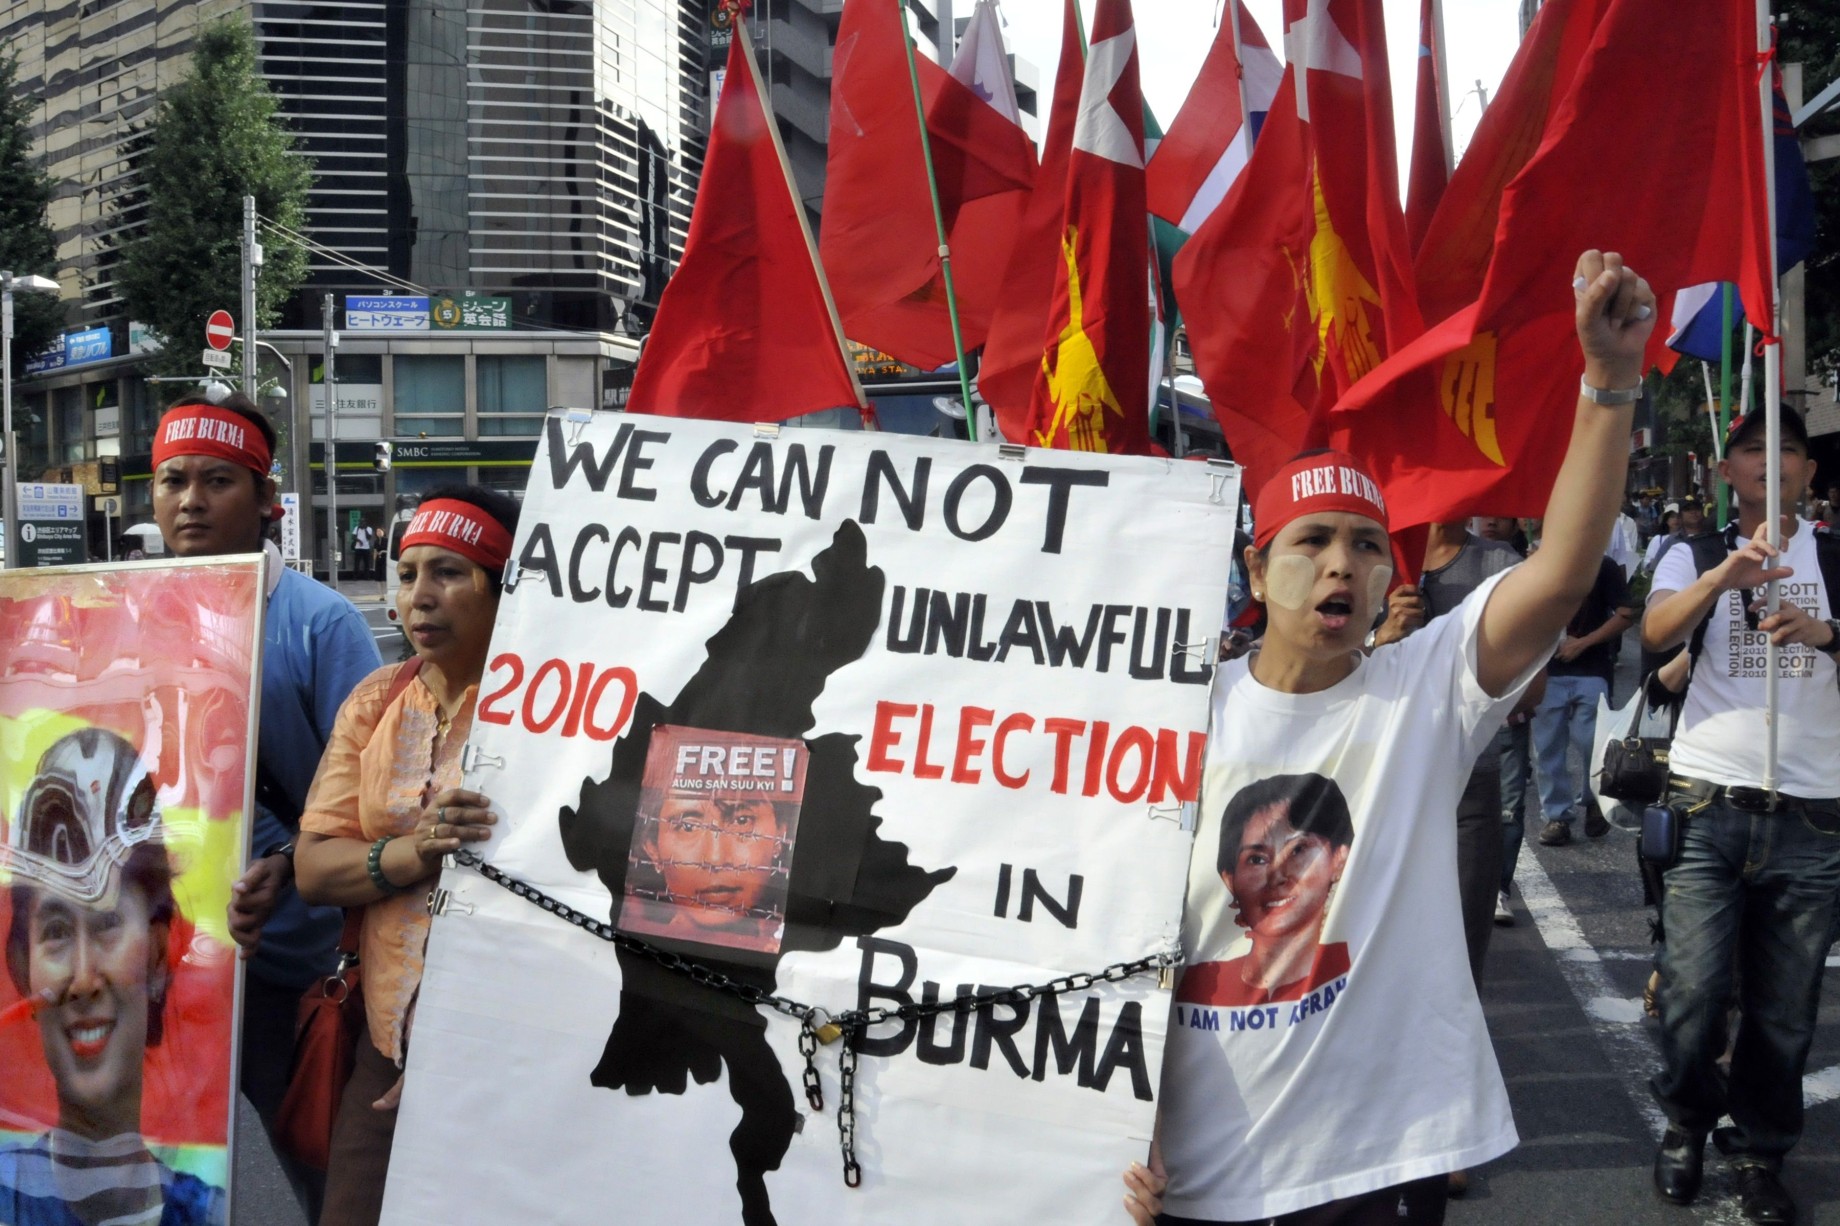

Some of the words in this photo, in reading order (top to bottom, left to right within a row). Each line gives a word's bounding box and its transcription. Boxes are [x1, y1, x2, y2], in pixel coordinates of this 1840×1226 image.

[357, 301, 418, 309] パソコンスクール
[462, 301, 507, 313] シェーン
[463, 313, 507, 328] 英会話
[882, 365, 908, 374] STA.
[315, 399, 377, 410] 三住友銀行
[164, 417, 197, 445] FREE
[196, 417, 244, 450] BURMA
[397, 447, 429, 457] SMBC
[547, 417, 672, 501] WE
[690, 438, 836, 520] CAN
[859, 450, 1110, 554] NOT
[1291, 465, 1337, 502] FREE
[426, 510, 483, 545] BURMA
[504, 522, 782, 614] ACCEPT
[887, 585, 1213, 685] UNLAWFUL
[1756, 583, 1818, 597] OCOTT
[1728, 620, 1740, 678] ELECTION
[1743, 655, 1817, 669] BOCOTT
[478, 652, 638, 741] 2010
[866, 700, 1207, 804] ELECTION
[676, 745, 796, 792] FREE!
[671, 779, 703, 789] AUNG
[704, 780, 728, 789] SAN
[730, 780, 754, 790] SUU
[756, 781, 775, 790] KYI
[994, 863, 1084, 929] IN
[850, 934, 1153, 1102] BURMA
[1177, 1006, 1184, 1026] I
[1190, 1008, 1220, 1031] AM
[1229, 1007, 1278, 1031] NOT
